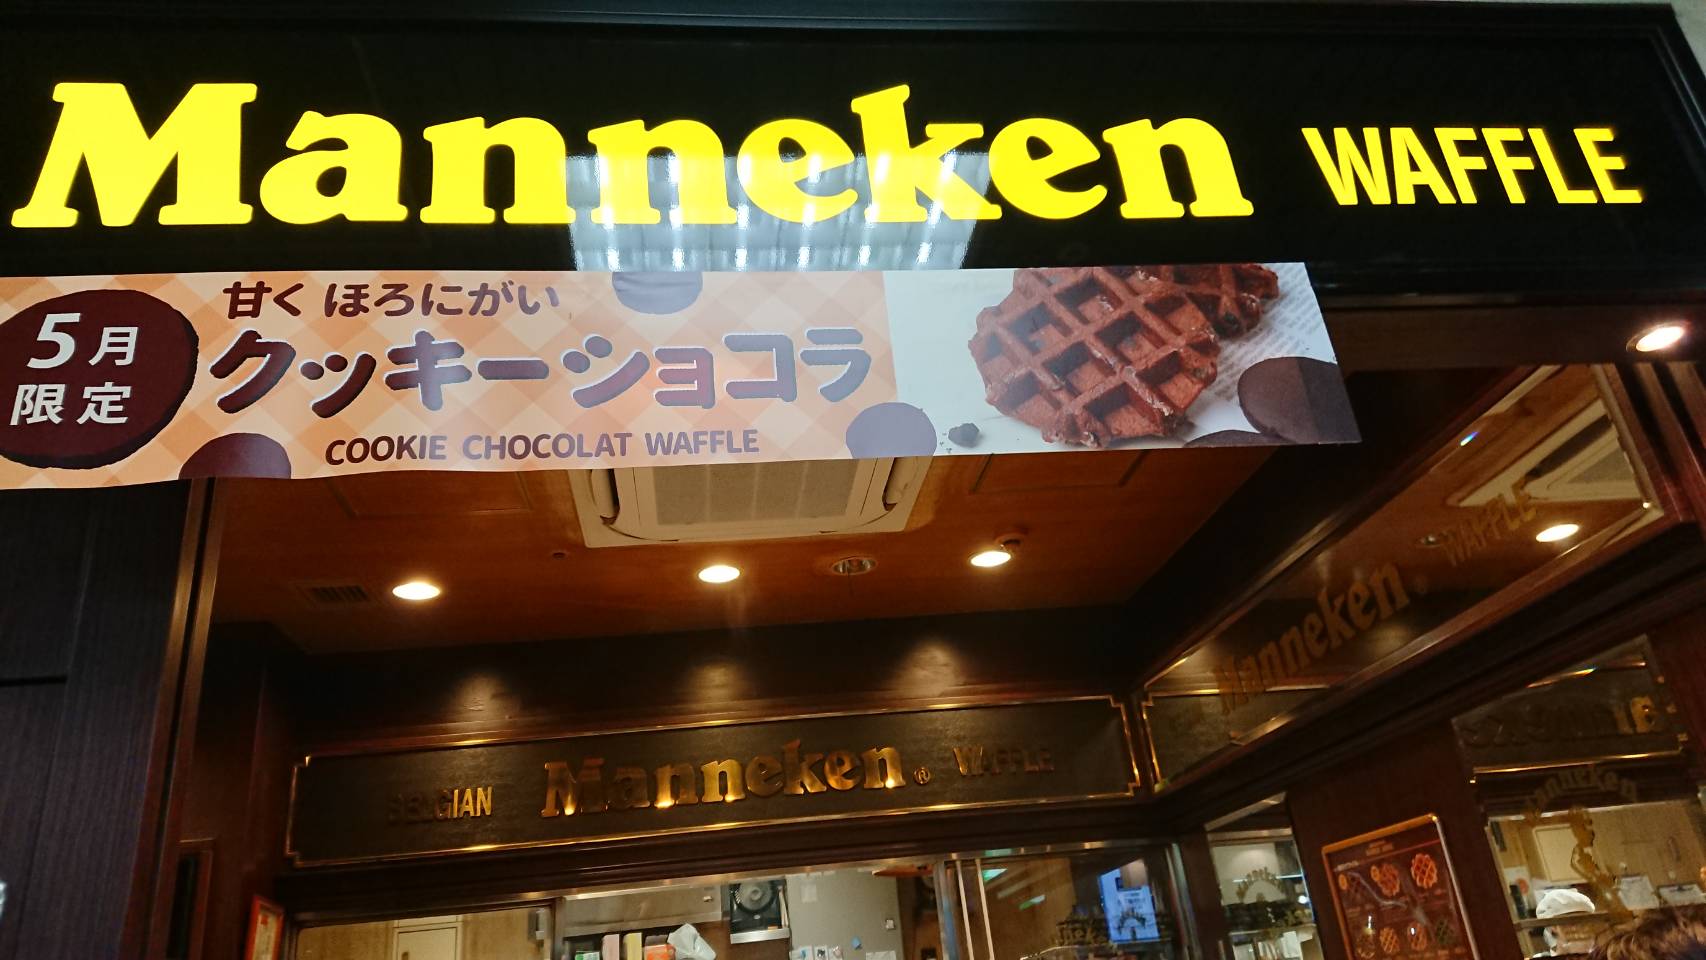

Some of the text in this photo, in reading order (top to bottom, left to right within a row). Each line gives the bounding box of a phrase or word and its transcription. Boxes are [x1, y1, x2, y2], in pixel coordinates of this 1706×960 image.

[11, 82, 1643, 228] Manneken WAFFLE
[222, 279, 561, 320] 甘く ほろにがい
[9, 381, 132, 426] 限定
[208, 327, 873, 419] クッキーショコラ
[325, 429, 760, 466] COOKIE CHOCOLAT WAFFLE
[1212, 561, 1411, 714] Manneken
[541, 738, 908, 818] Manneken
